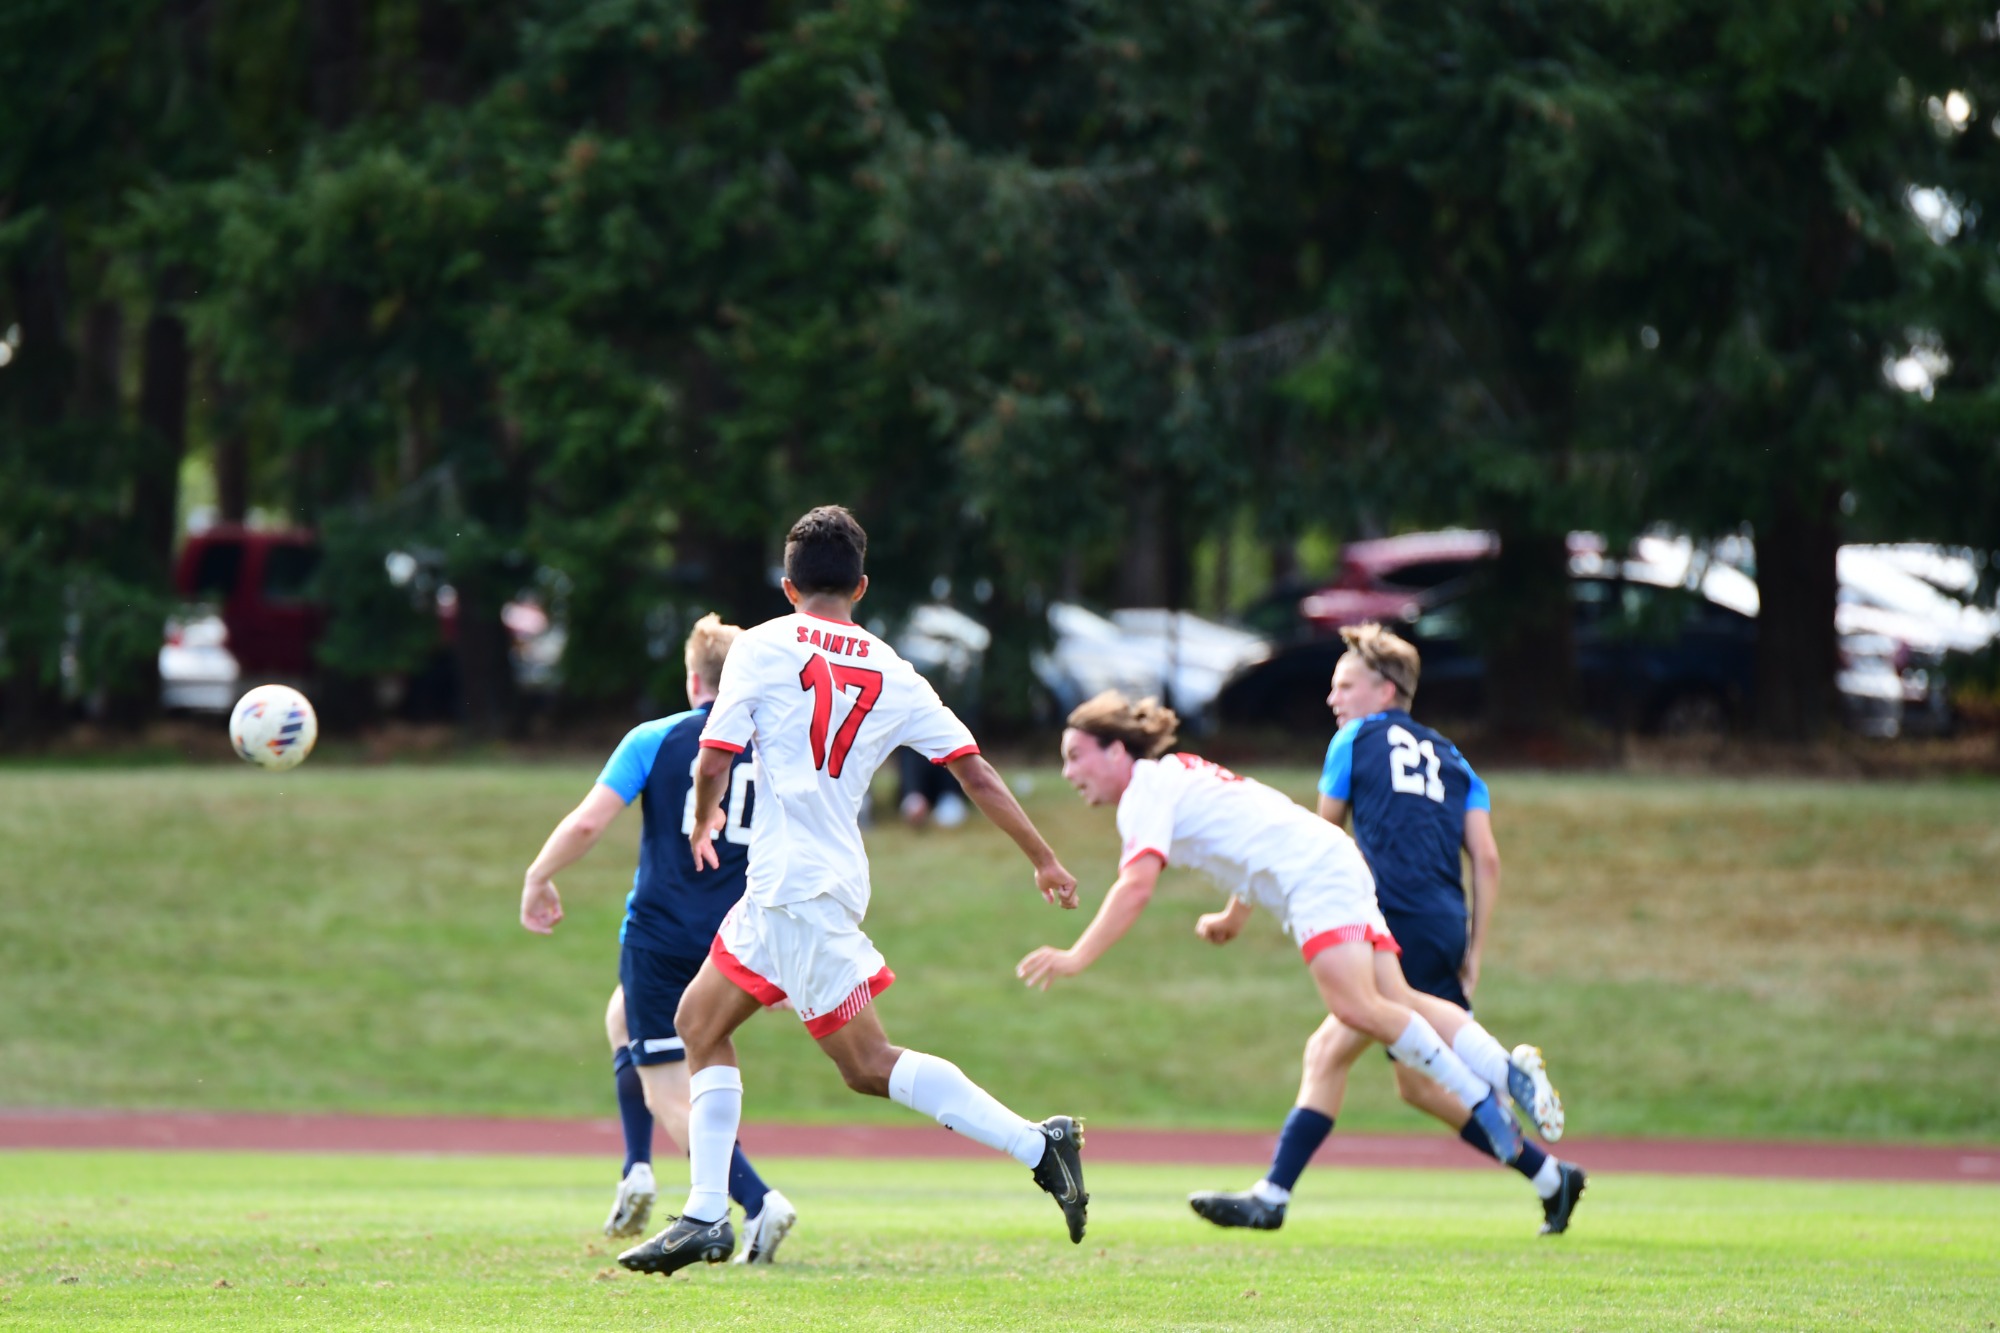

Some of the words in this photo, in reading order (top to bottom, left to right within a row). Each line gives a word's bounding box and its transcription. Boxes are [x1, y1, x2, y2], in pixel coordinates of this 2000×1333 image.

[797, 626, 870, 657] SAINTS
[799, 653, 883, 779] 17
[1387, 724, 1445, 803] 21
